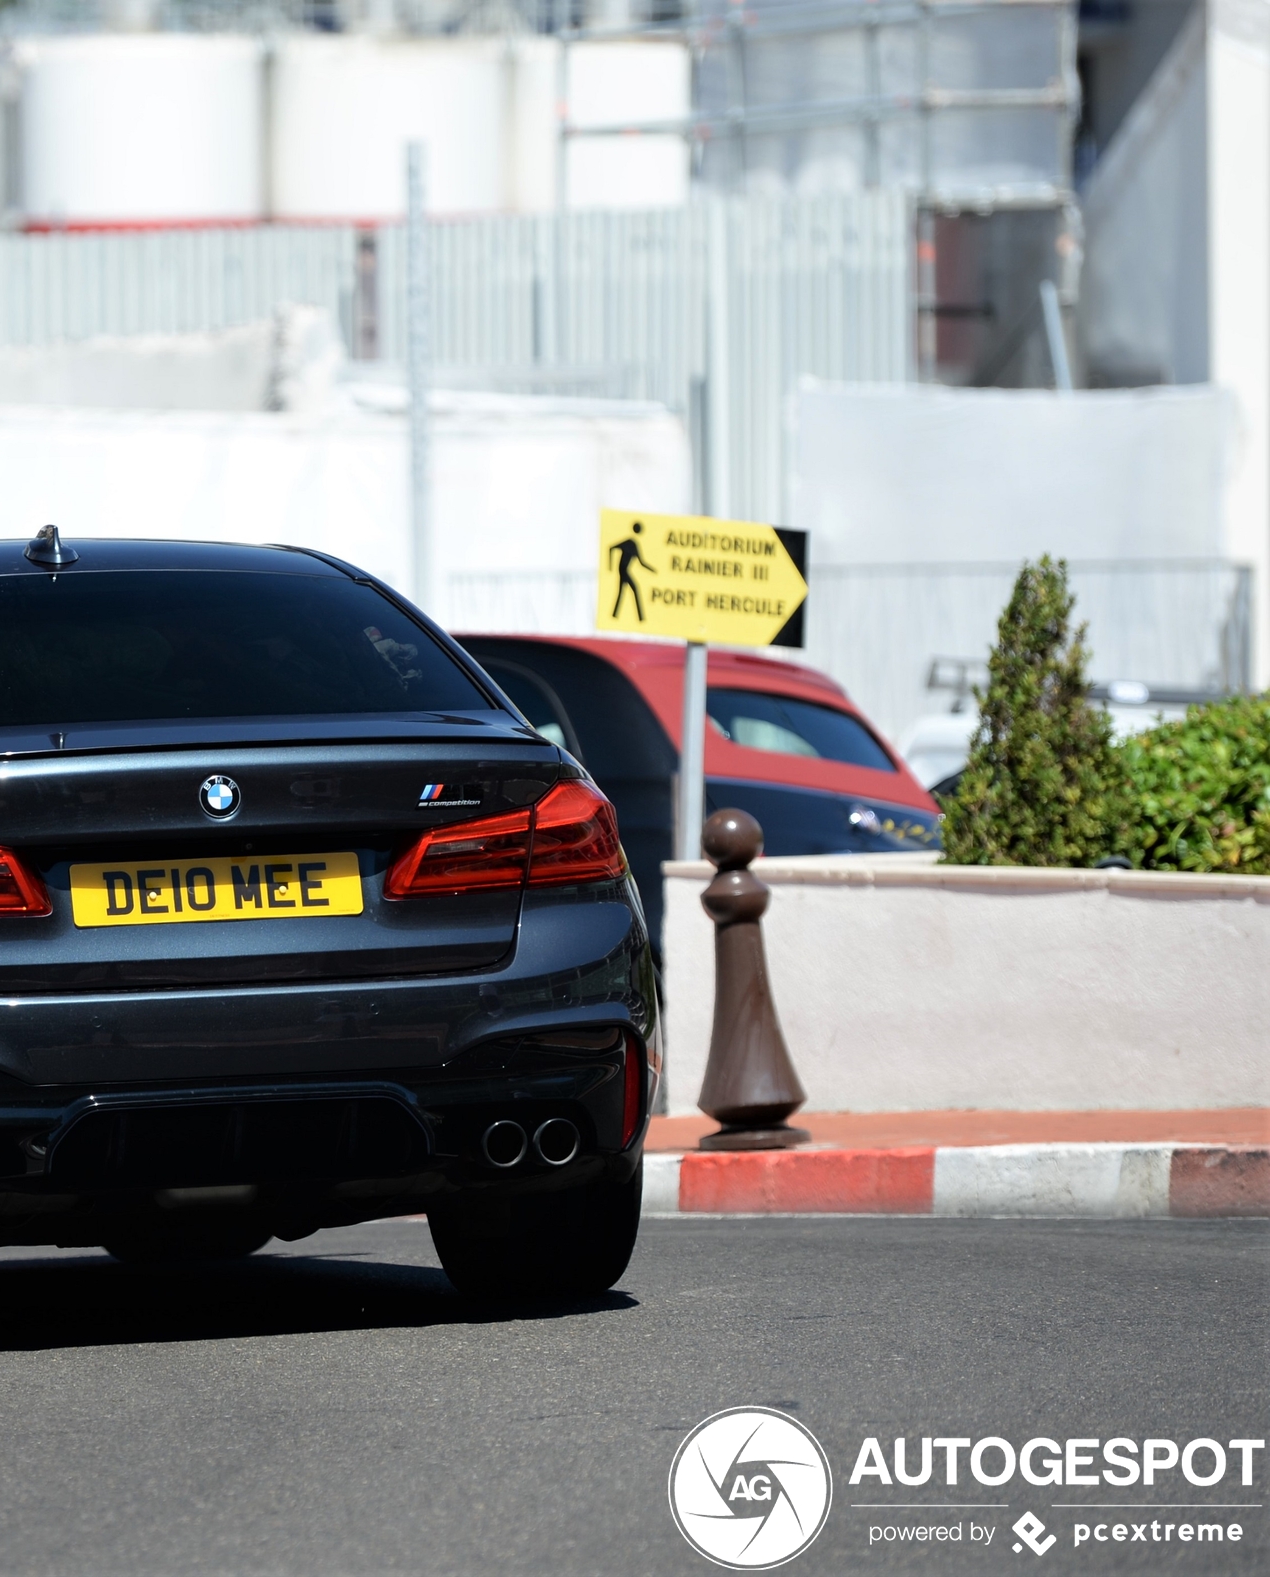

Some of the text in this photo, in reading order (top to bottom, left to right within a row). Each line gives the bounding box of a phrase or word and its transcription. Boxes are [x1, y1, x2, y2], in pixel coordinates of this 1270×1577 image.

[665, 530, 777, 557] AUDITORIUM
[671, 555, 769, 581] RAINIER III
[650, 587, 787, 617] PORT HERCULE
[203, 776, 237, 791] BMW
[428, 799, 481, 807] competition
[231, 862, 330, 909] MEE
